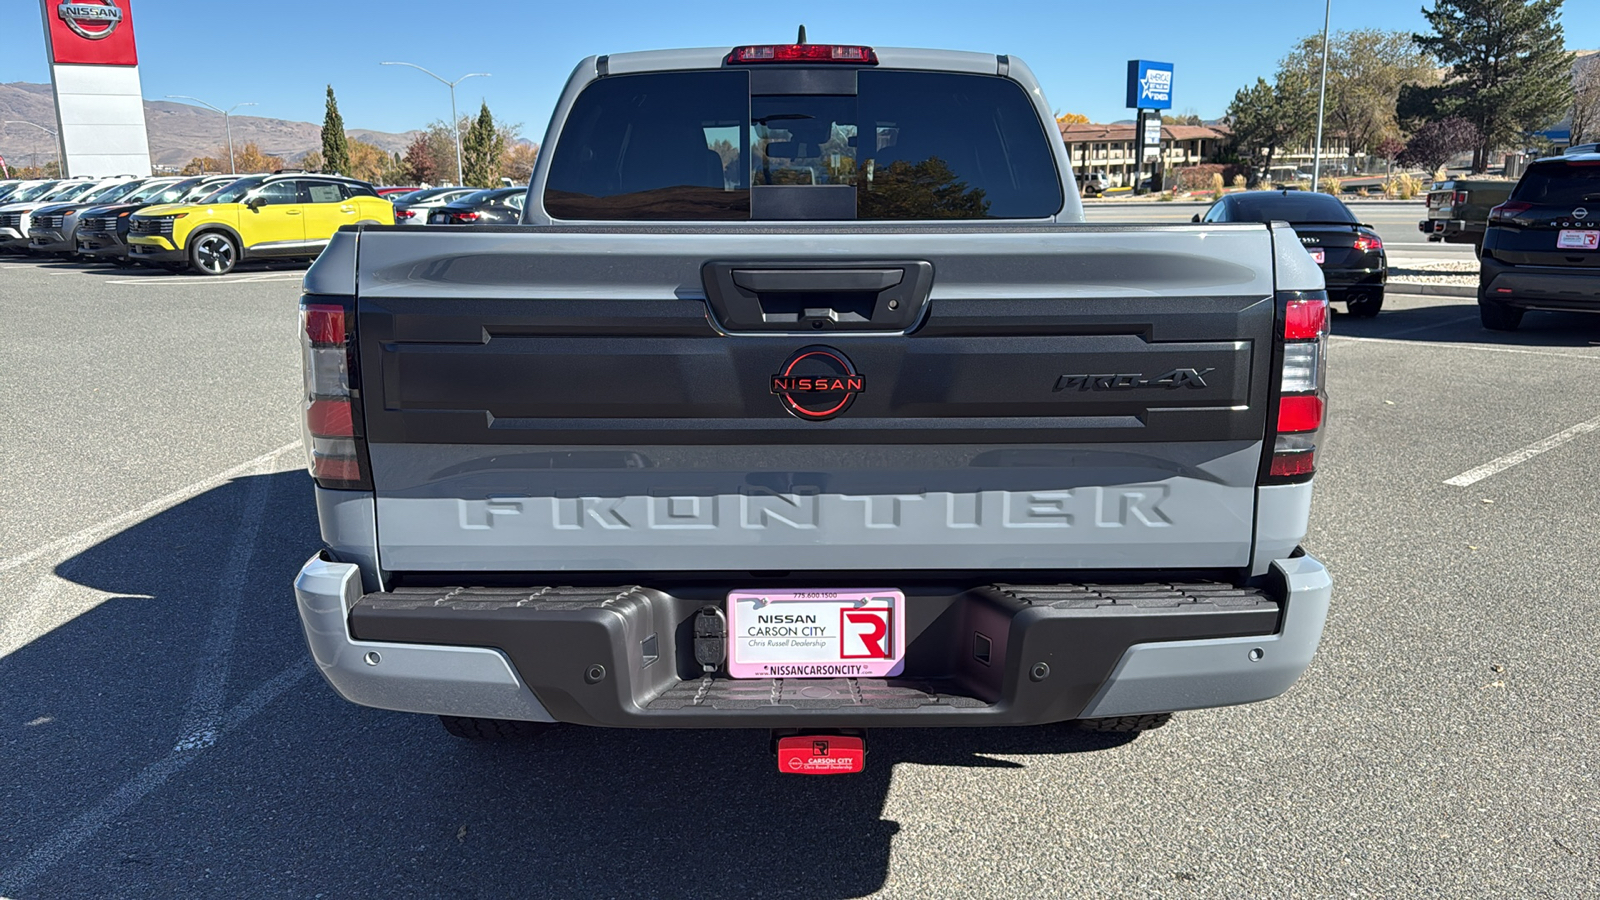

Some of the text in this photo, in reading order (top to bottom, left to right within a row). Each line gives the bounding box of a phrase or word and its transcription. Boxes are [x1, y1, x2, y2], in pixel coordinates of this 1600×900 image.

[66, 7, 118, 17] NISSAN
[774, 379, 862, 390] NISSAN
[1052, 367, 1215, 392] PRO-4X
[457, 485, 1173, 530] FRONTIER
[758, 615, 816, 624] NISSAN
[747, 626, 827, 637] CARSON CITY
[845, 613, 888, 656] R
[748, 639, 827, 649] Chris Russell Dealership
